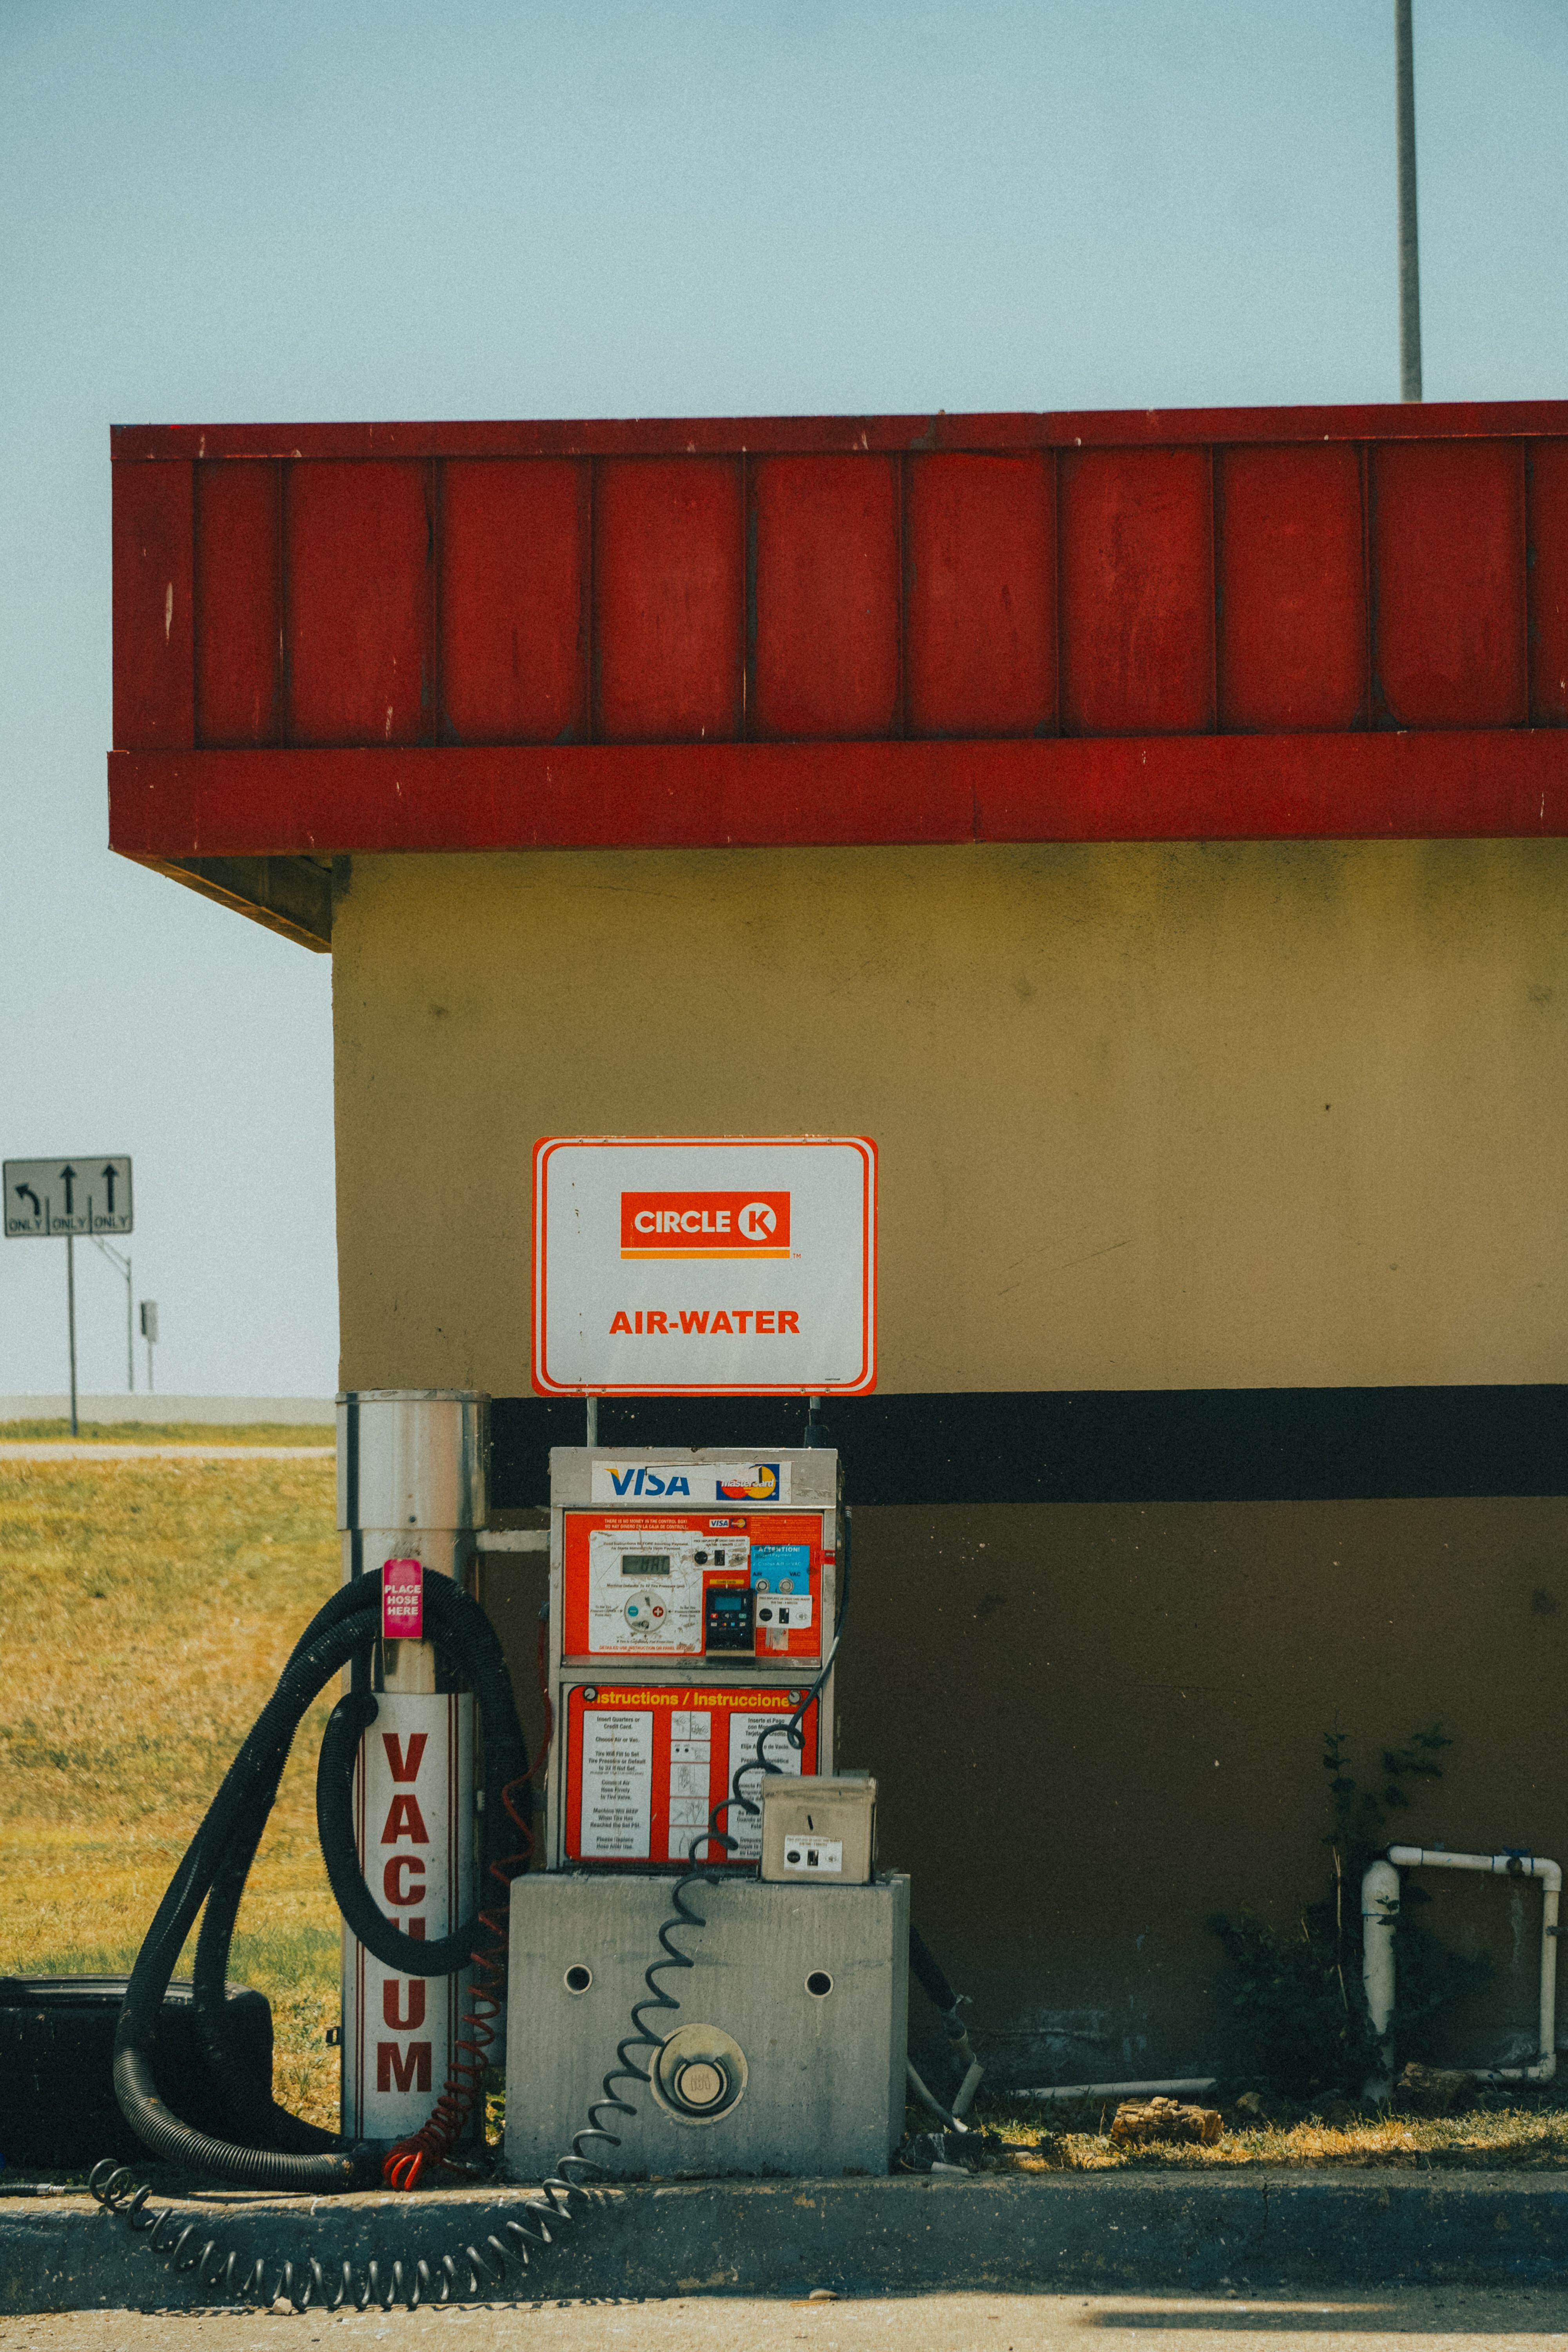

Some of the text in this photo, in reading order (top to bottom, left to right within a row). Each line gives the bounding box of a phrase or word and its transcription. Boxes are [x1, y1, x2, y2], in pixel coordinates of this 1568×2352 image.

[9, 1216, 128, 1232] ONLY ONLY ONLY
[635, 1207, 775, 1239] CIRCLE K
[609, 1310, 800, 1334] AIR-WATER
[604, 1468, 690, 1495] VISA
[384, 1585, 421, 1593] PLACE
[387, 1595, 419, 1604] HOSE
[387, 1606, 419, 1615] HERE
[587, 1691, 797, 1707] nstructions / Instruccione
